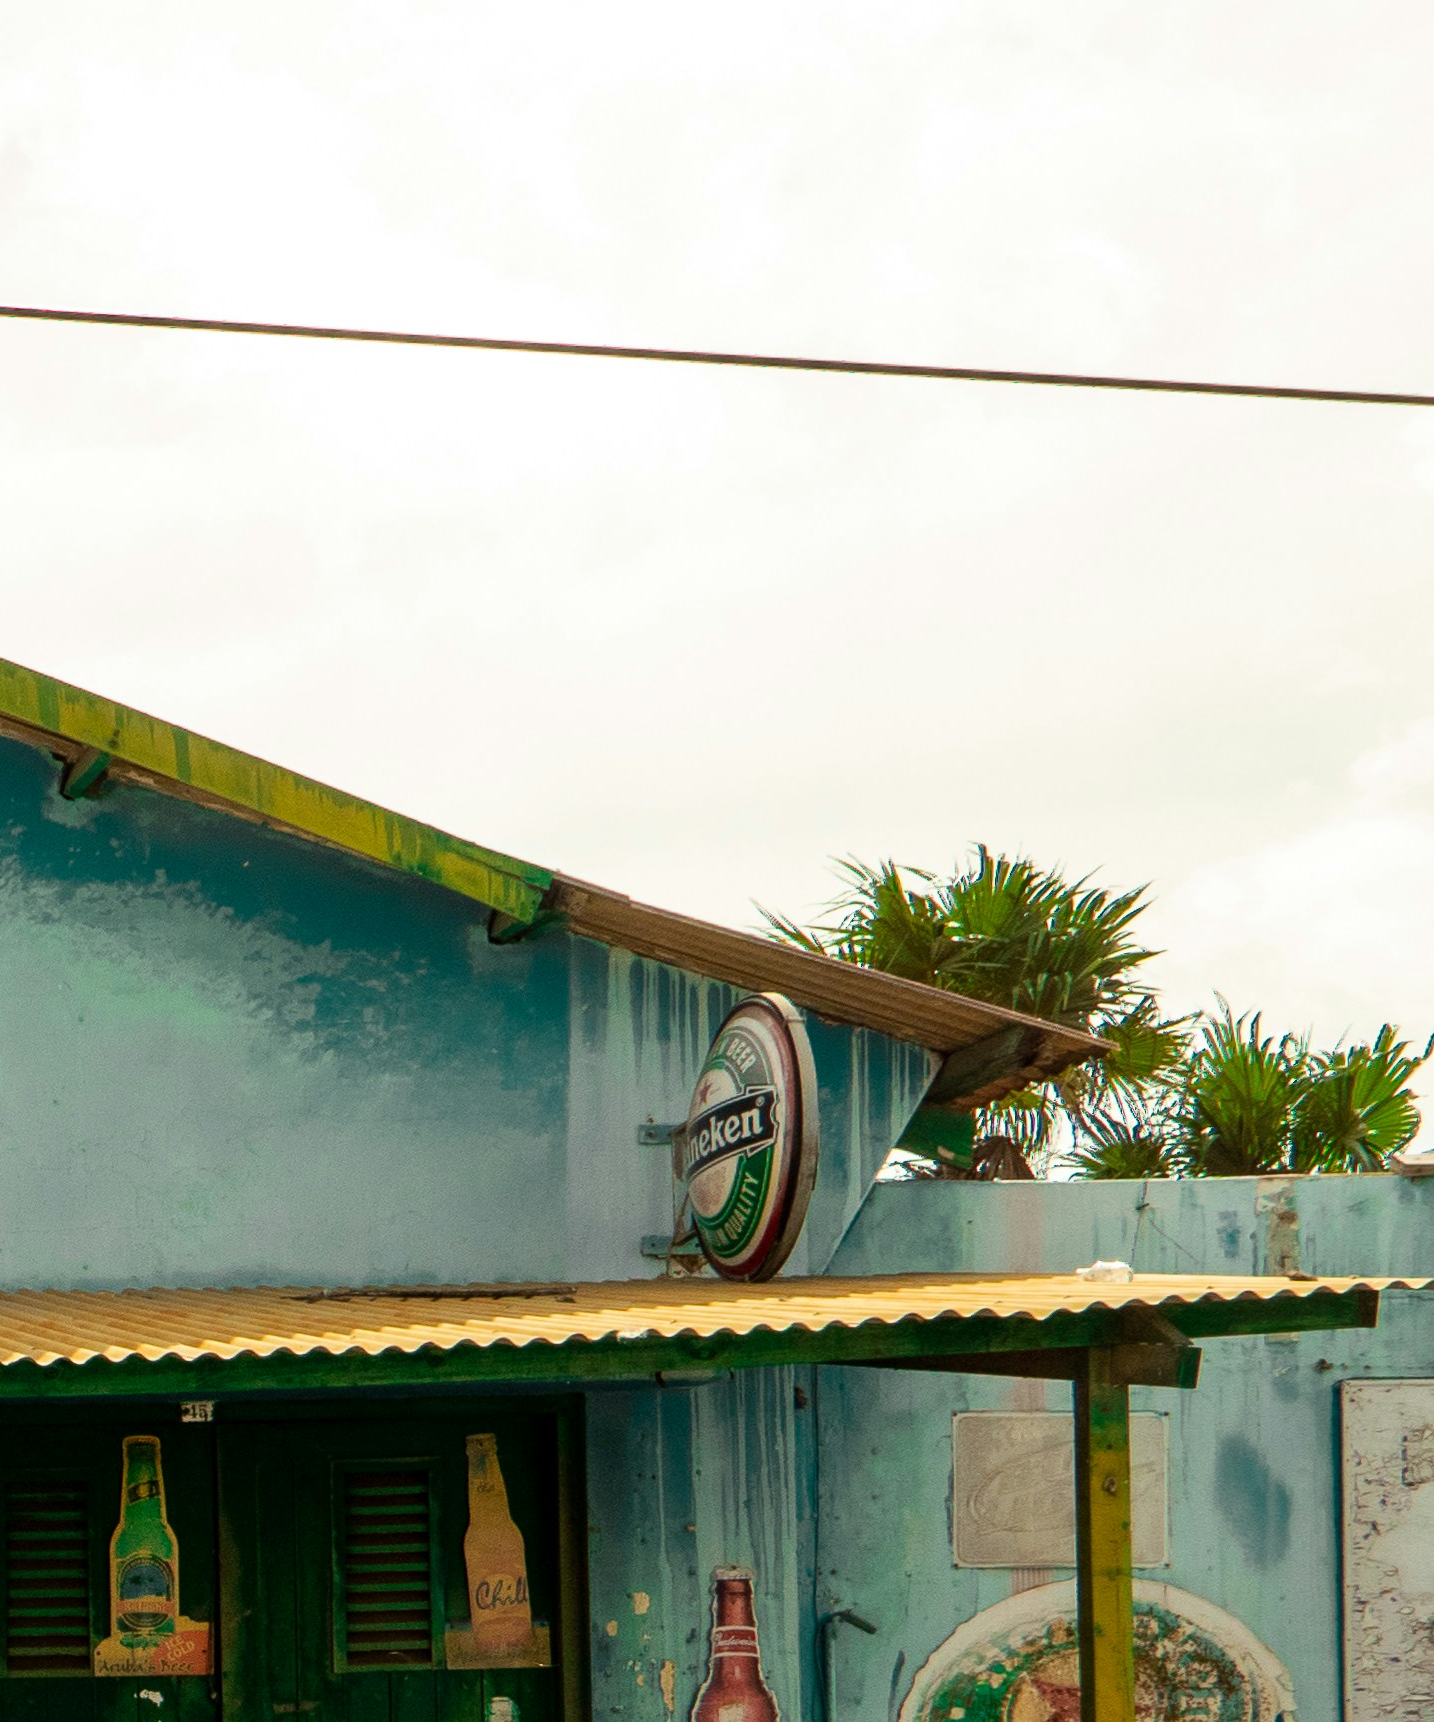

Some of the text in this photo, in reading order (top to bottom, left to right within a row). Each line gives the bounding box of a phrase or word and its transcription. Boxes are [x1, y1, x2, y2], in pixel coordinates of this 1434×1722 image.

[726, 1038, 756, 1073] BEER
[723, 1171, 759, 1241] QUALITY
[476, 1576, 528, 1610] Chill
[166, 1640, 195, 1661] COLD
